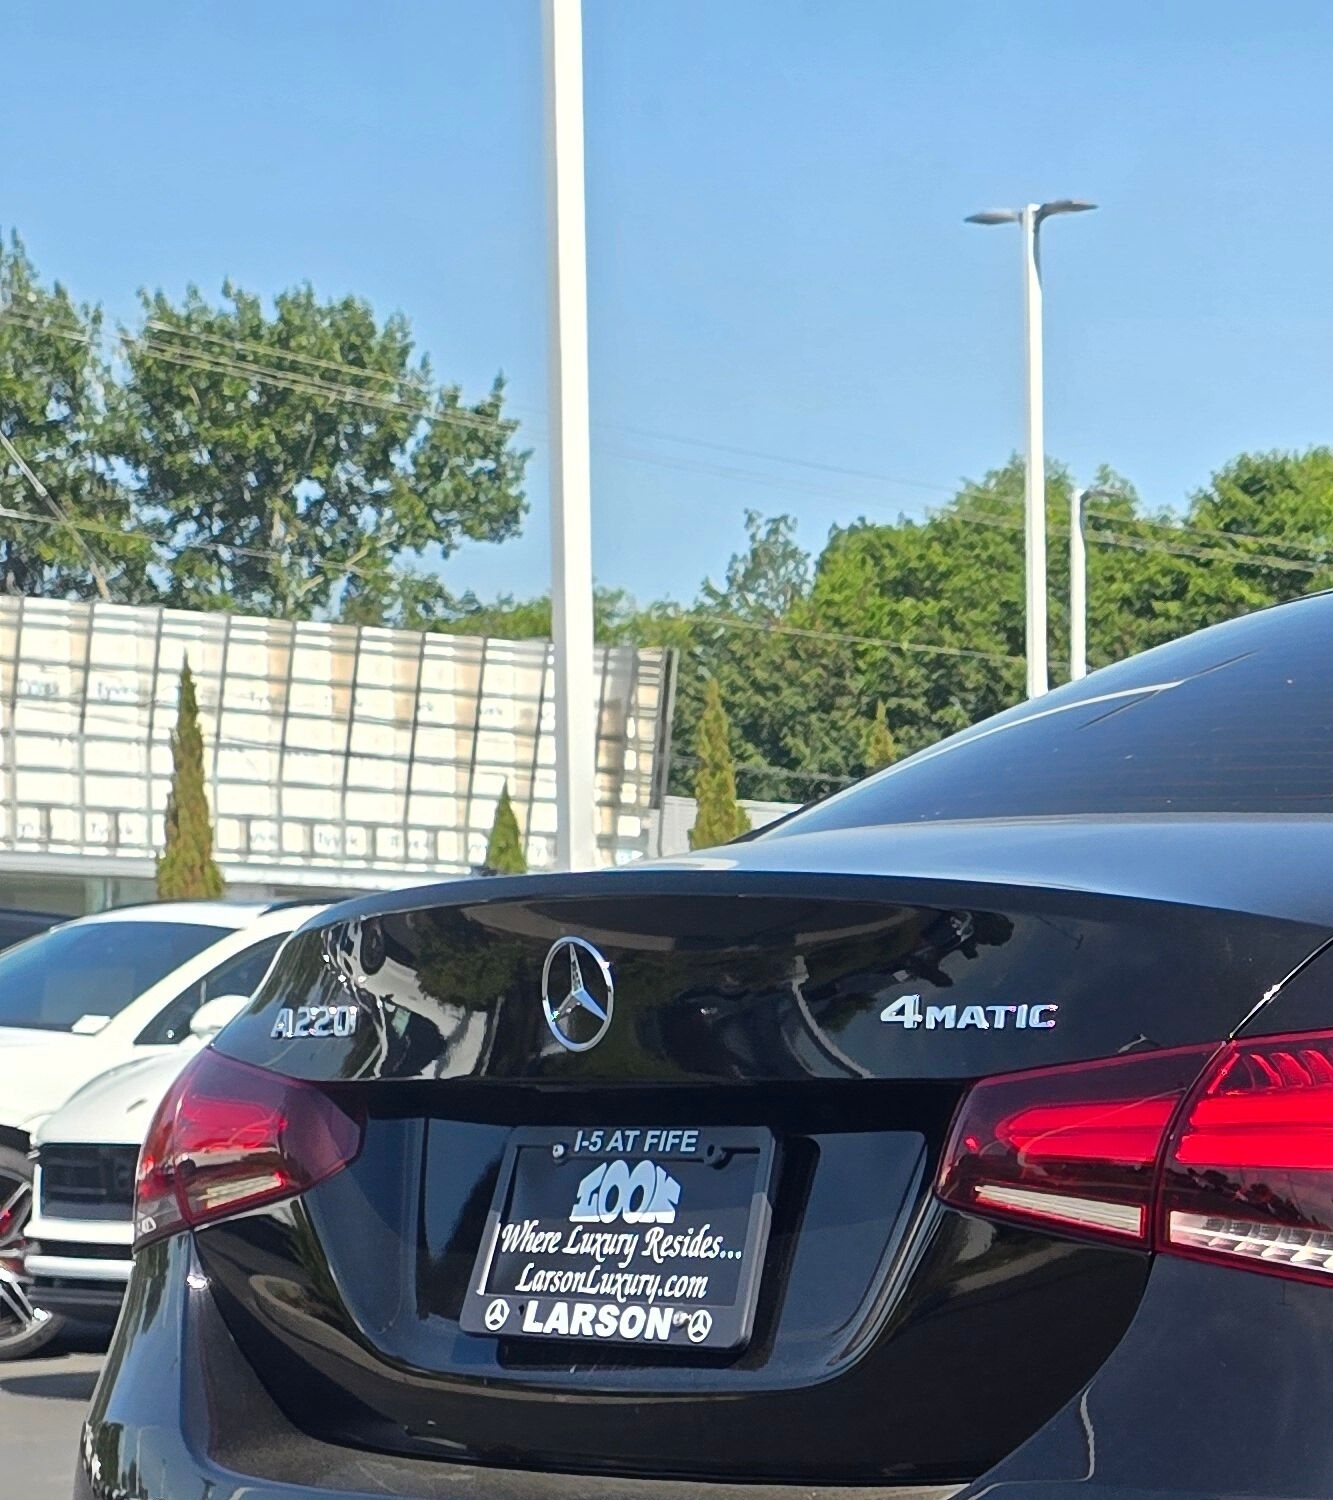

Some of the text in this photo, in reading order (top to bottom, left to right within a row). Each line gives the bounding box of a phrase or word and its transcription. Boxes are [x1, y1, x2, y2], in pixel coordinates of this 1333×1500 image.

[270, 1005, 350, 1037] A220
[880, 994, 1059, 1030] 4MATIC
[574, 1130, 698, 1153] I-5 AT FIFE
[501, 1219, 742, 1268] Where Luxury Resides...
[515, 1262, 708, 1304] LarsonLuxury.com
[522, 1300, 674, 1340] LARSON
